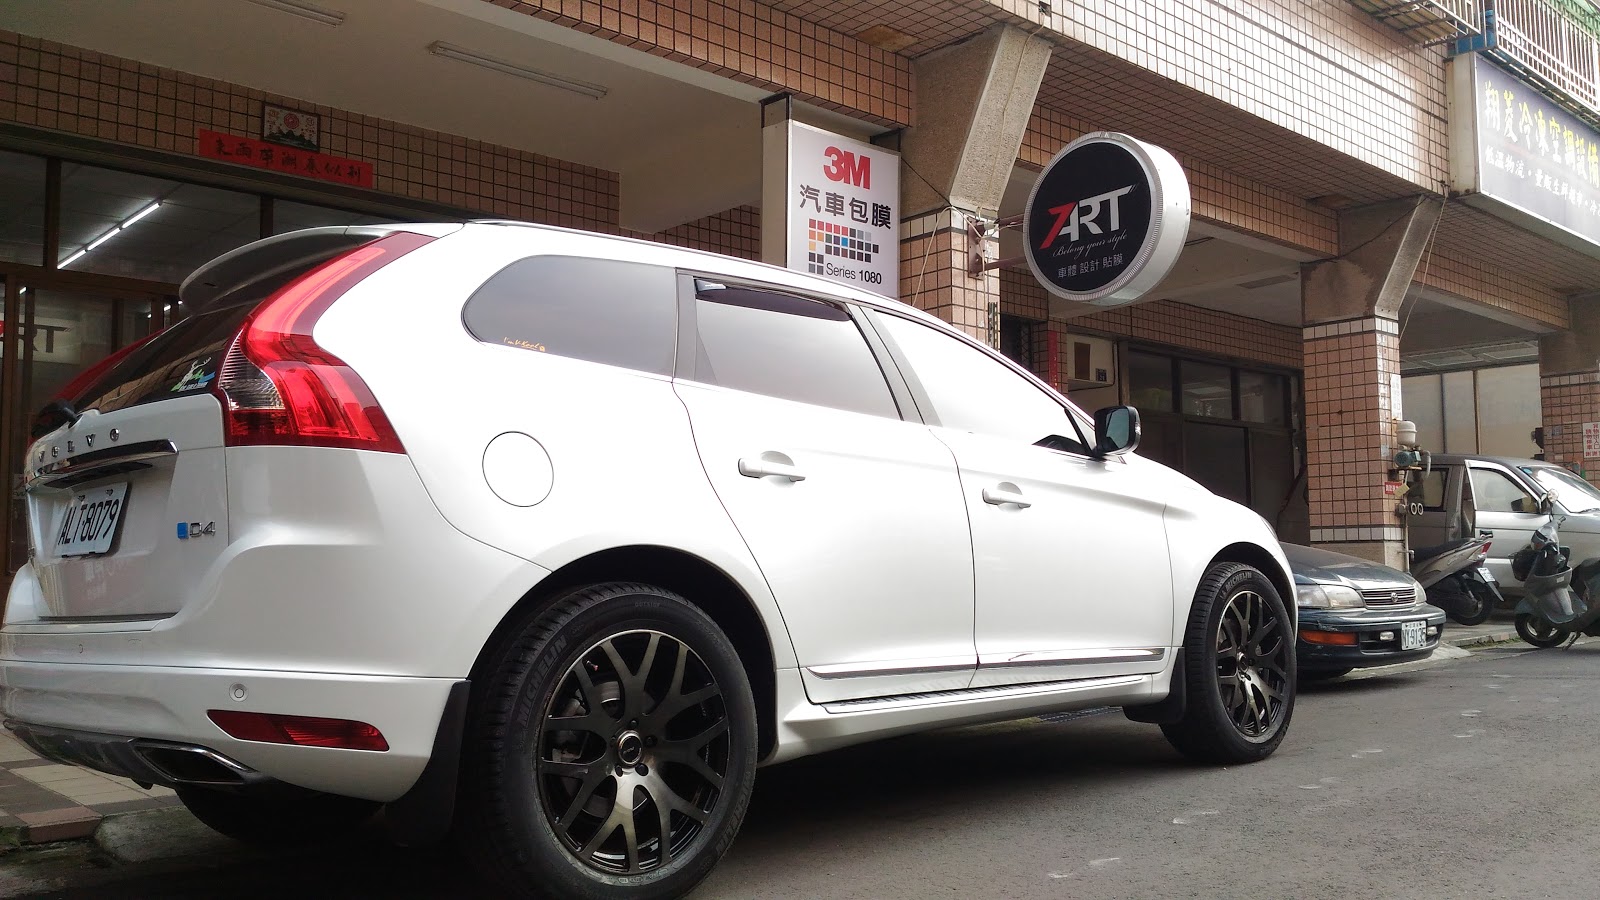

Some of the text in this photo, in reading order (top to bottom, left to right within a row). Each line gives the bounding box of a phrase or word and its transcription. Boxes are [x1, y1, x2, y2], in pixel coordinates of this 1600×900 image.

[823, 145, 871, 191] 3M
[799, 183, 892, 230] 汽車包膜
[1053, 229, 1129, 260] Belong your style
[825, 262, 882, 285] Series 1080
[1057, 265, 1078, 279] 車體
[1079, 258, 1100, 274] 設計
[38, 427, 121, 463] VOLVO
[189, 521, 216, 537] D4
